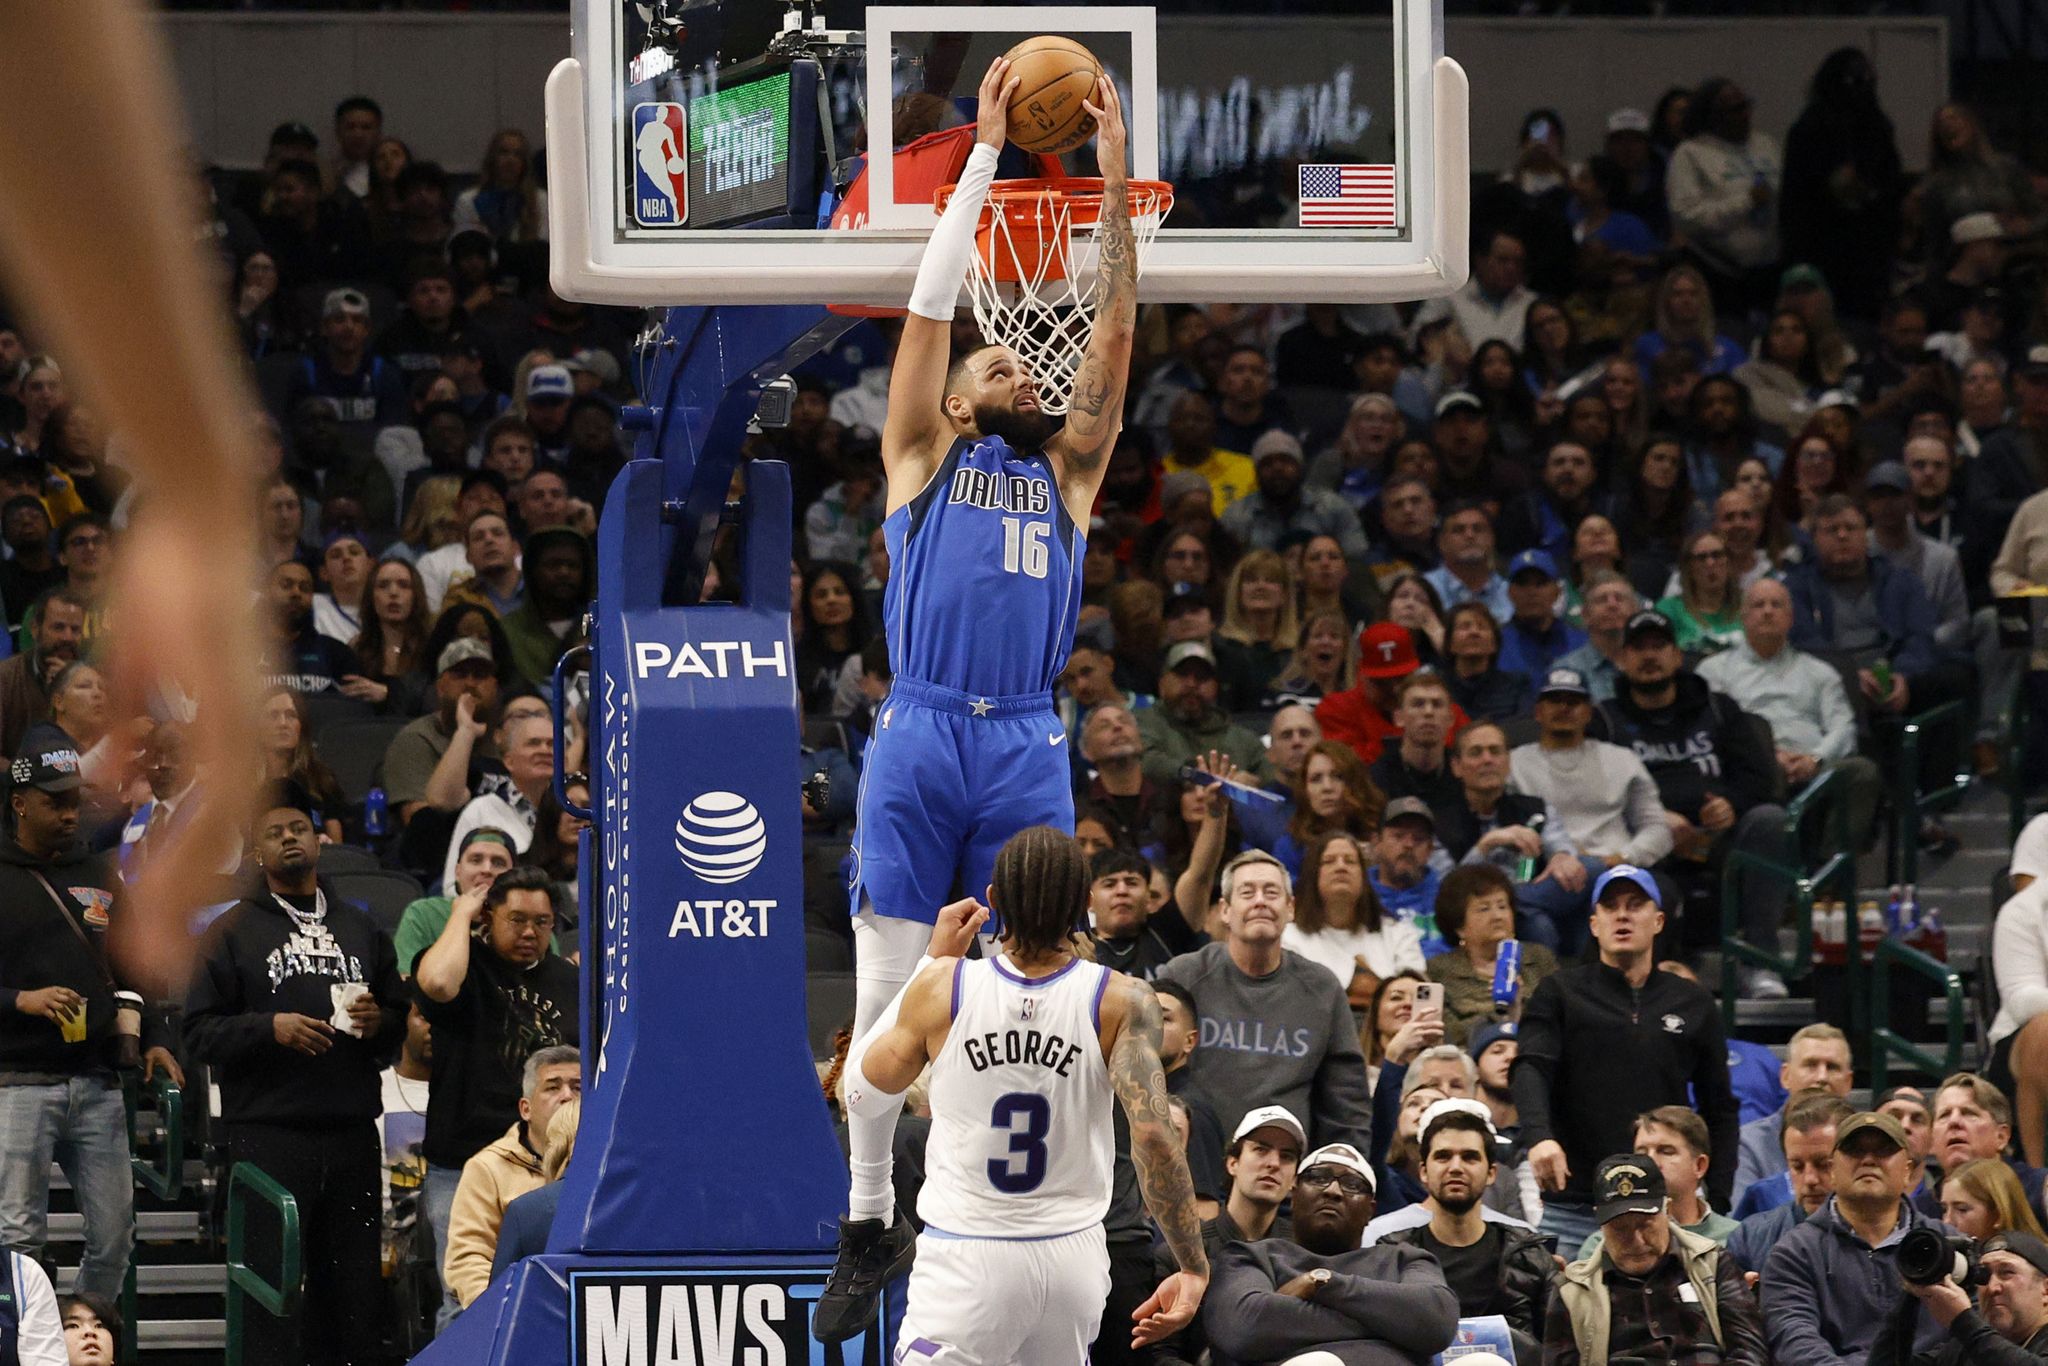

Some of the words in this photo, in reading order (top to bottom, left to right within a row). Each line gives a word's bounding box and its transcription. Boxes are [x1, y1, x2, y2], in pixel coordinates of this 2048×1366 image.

[643, 198, 667, 218] NBA
[948, 467, 1051, 515] DALLAS
[1002, 516, 1051, 579] 16
[634, 641, 788, 679] PATH
[1377, 641, 1396, 661] T
[621, 691, 630, 832] RESORTS
[667, 899, 778, 938] AT&T
[619, 873, 630, 1014] CASINOS
[964, 1030, 1083, 1078] GEORGE
[1199, 1017, 1310, 1057] DALLAS
[987, 1092, 1050, 1194] 3
